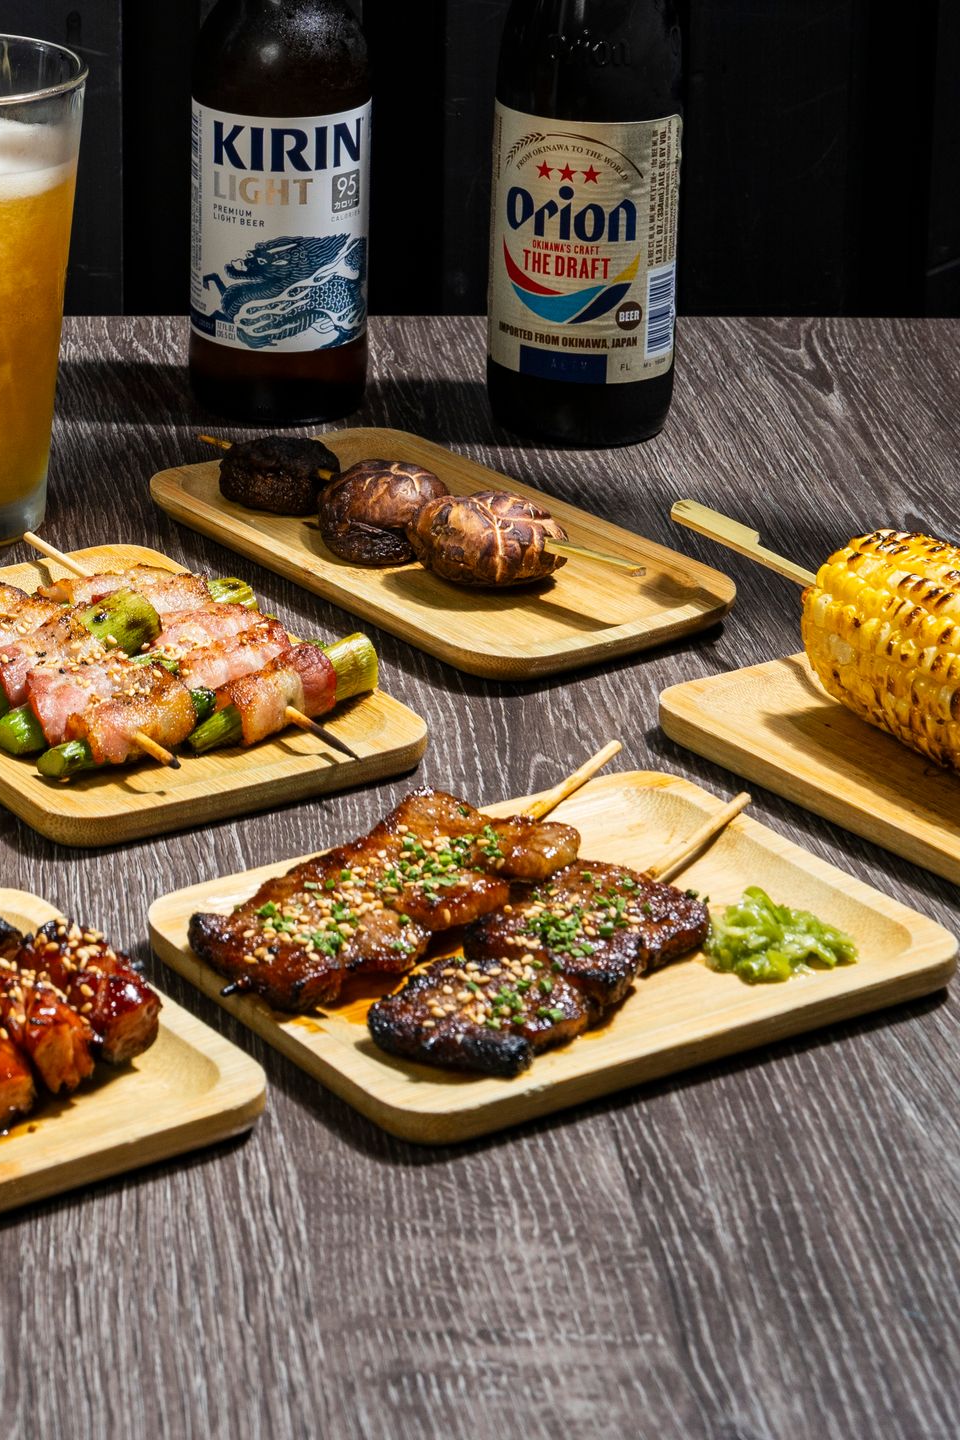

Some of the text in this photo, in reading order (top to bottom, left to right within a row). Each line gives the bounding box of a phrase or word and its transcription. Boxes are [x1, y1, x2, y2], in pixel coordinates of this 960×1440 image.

[213, 117, 362, 172] KIRIN
[659, 147, 666, 157] BY
[516, 144, 629, 181] FROM OKINAWA TO THE WORLD
[214, 171, 313, 206] LIGHT
[337, 174, 357, 199] 95
[213, 203, 252, 218] PREMIUM
[334, 198, 359, 209] カロリー
[507, 185, 637, 242] Orion
[213, 213, 265, 227] LIGHT BEER
[532, 239, 600, 255] OKINAWA'S CRAFT
[523, 249, 611, 279] THE DRAFT
[619, 311, 639, 322] BEER
[499, 321, 638, 349] IMPORTED FROM OKINAWA, JAPAN
